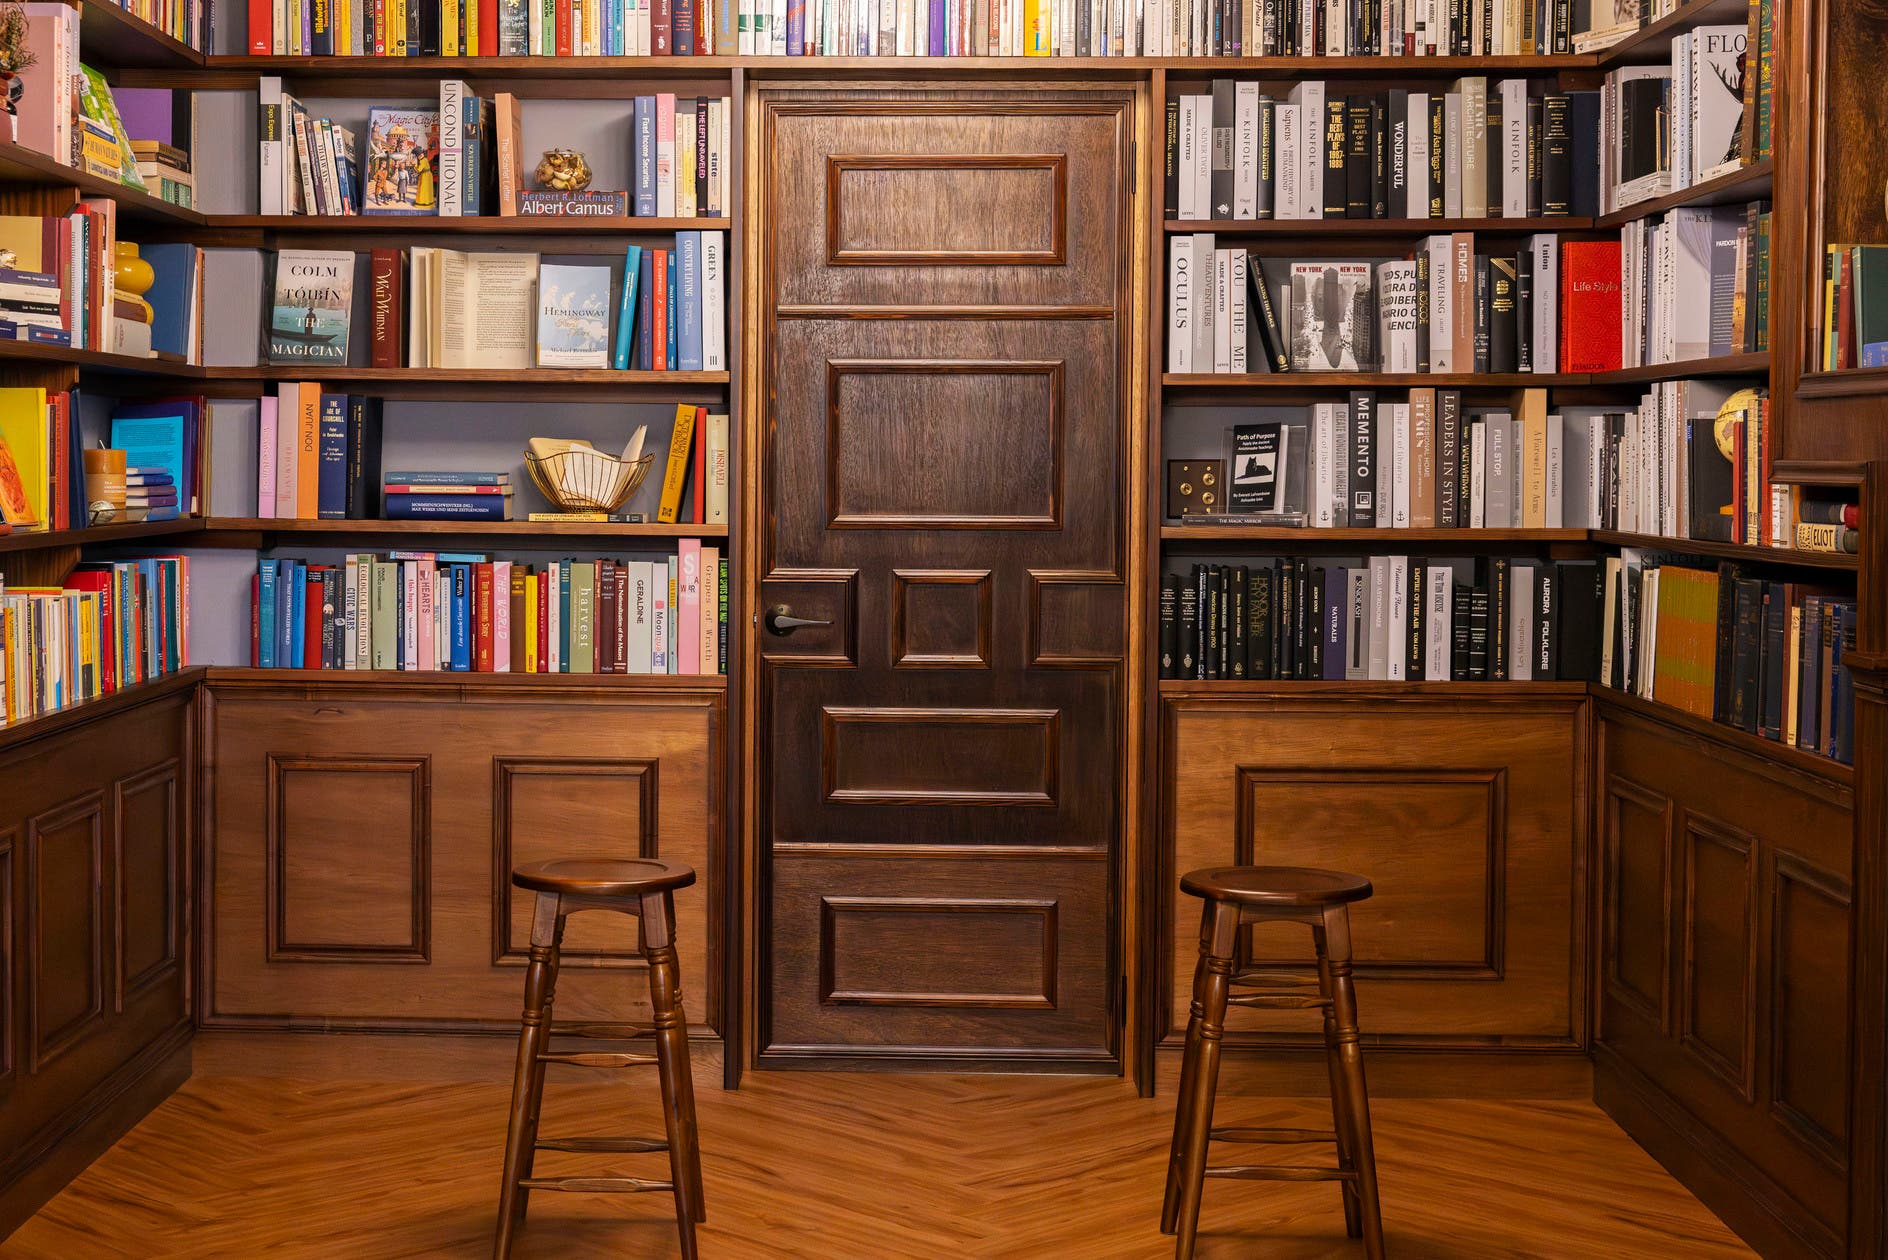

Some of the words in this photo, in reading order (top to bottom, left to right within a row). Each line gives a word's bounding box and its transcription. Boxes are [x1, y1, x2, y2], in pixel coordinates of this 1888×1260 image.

[1706, 34, 1747, 53] FLO
[379, 112, 413, 128] Magic
[642, 117, 650, 134] Fixed
[698, 110, 706, 123] THE
[1283, 109, 1294, 141] Sapiens
[1329, 123, 1343, 133] BEST
[1331, 115, 1342, 124] THE
[698, 124, 706, 138] LEFT
[1327, 132, 1345, 142] PLAYS
[1433, 134, 1442, 148] Asa
[1465, 94, 1475, 170] ARCHITECTURE
[501, 138, 510, 152] The
[642, 135, 650, 158] Income
[1242, 120, 1250, 168] KINFOLK
[1332, 141, 1341, 150] OF
[1394, 120, 1404, 189] WONDERFUL
[1511, 120, 1520, 174] KINFOLK
[501, 153, 510, 179] Scarlet
[698, 139, 706, 179] UNRAVELED
[1329, 159, 1343, 169] 1988
[1432, 148, 1441, 170] Briggs
[642, 157, 650, 189] Securities
[503, 180, 511, 202] Letter
[521, 192, 560, 201] Herbert
[573, 193, 614, 201] Lottman
[521, 201, 564, 215] Albert
[566, 201, 614, 215] Camus
[684, 239, 694, 272] COUNTRY
[708, 245, 716, 281] GREEN
[1458, 242, 1468, 283] HOMES
[1542, 243, 1550, 270] Union
[291, 265, 337, 277] COLM
[1233, 253, 1245, 287] YOU
[283, 287, 341, 300] TÓIBÍN
[684, 272, 694, 297] LIVING
[1176, 257, 1188, 329] OCULUS
[1437, 262, 1446, 314] TRAVELING
[1573, 281, 1591, 291] Life
[1593, 281, 1617, 292] Style
[544, 306, 606, 318] HEMINGWAY
[1233, 299, 1245, 334] THE
[1419, 290, 1429, 324] ROSCOE
[295, 317, 325, 328] THE
[271, 344, 344, 357] MAGICIAN
[1233, 345, 1244, 369] ME
[329, 400, 338, 408] THE
[303, 403, 313, 430] JUAN
[1336, 411, 1347, 432] CREATE
[1444, 395, 1455, 457] LEADERS
[303, 430, 313, 453] DON
[1321, 440, 1328, 449] of
[1357, 397, 1370, 477] MEMENTO
[1494, 429, 1502, 451] FULL
[1336, 433, 1347, 469] WONDERFUL
[1462, 444, 1470, 462] WALT
[1533, 438, 1542, 476] Farewell
[716, 449, 725, 486] DISRAELI
[1444, 461, 1454, 476] IN
[1494, 452, 1502, 477] STOP.
[1336, 470, 1346, 498] HOMELIFE
[1462, 462, 1470, 499] WHITMAN
[1533, 480, 1541, 490] to
[1442, 480, 1453, 524] STYLE
[1532, 493, 1541, 514] Arms
[1813, 528, 1834, 548] ELIOT
[360, 565, 368, 605] ECOLOGICAL
[497, 574, 507, 595] THE
[704, 564, 713, 604] Grapes
[719, 578, 728, 595] SPOTS
[1250, 575, 1260, 599] THY
[1542, 577, 1551, 614] AURORA
[346, 587, 356, 607] CIVIC
[406, 592, 415, 613] happy
[421, 582, 430, 614] HEARTS
[636, 579, 644, 624] GERALDINE
[719, 594, 728, 602] ON
[1259, 577, 1268, 616] HONOR
[1413, 593, 1420, 603] OF
[346, 609, 356, 631] WARS
[497, 598, 507, 640] WORLD
[580, 587, 592, 646] harvest
[704, 609, 713, 623] of
[720, 611, 728, 623] MAP
[1250, 600, 1260, 637] FATHER
[360, 608, 368, 654] REVOLUTIONS
[481, 622, 490, 638] STORY
[704, 628, 713, 661] Wrath
[1541, 620, 1550, 670] FOLKLORE
